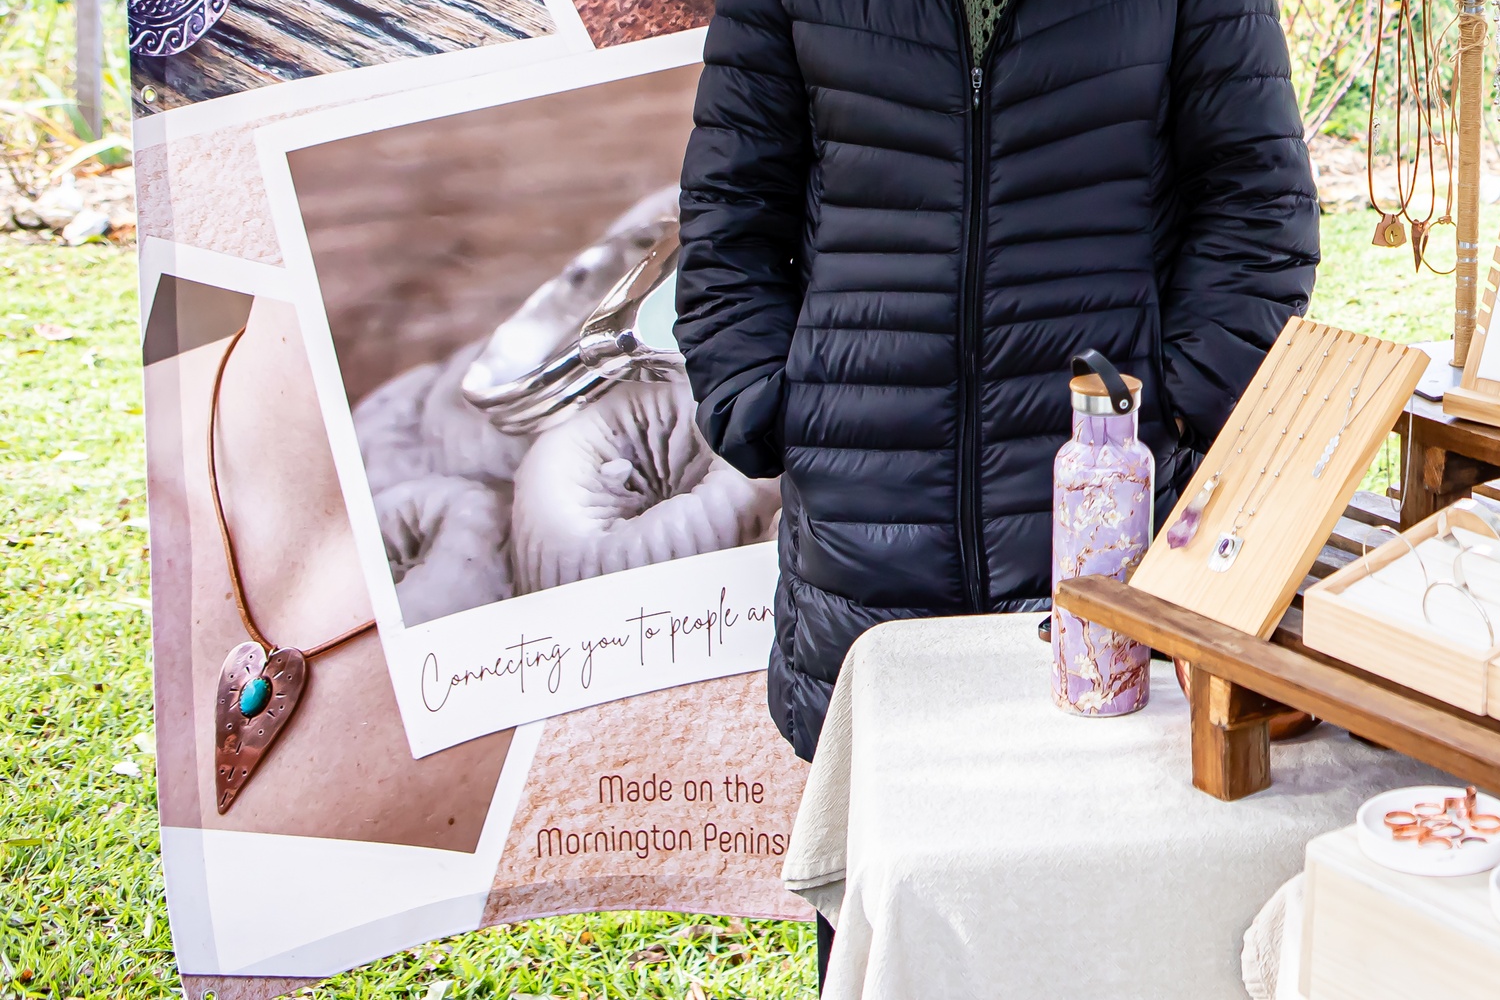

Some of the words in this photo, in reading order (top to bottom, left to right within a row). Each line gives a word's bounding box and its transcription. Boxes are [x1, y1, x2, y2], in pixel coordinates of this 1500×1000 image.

[421, 634, 570, 712] Connecting
[580, 634, 630, 689] you
[626, 606, 671, 666] to
[669, 586, 739, 663] people
[598, 773, 673, 804] Made
[684, 778, 714, 803] on
[722, 774, 765, 804] the
[536, 824, 693, 859] Mornington
[703, 822, 791, 856] Penins
